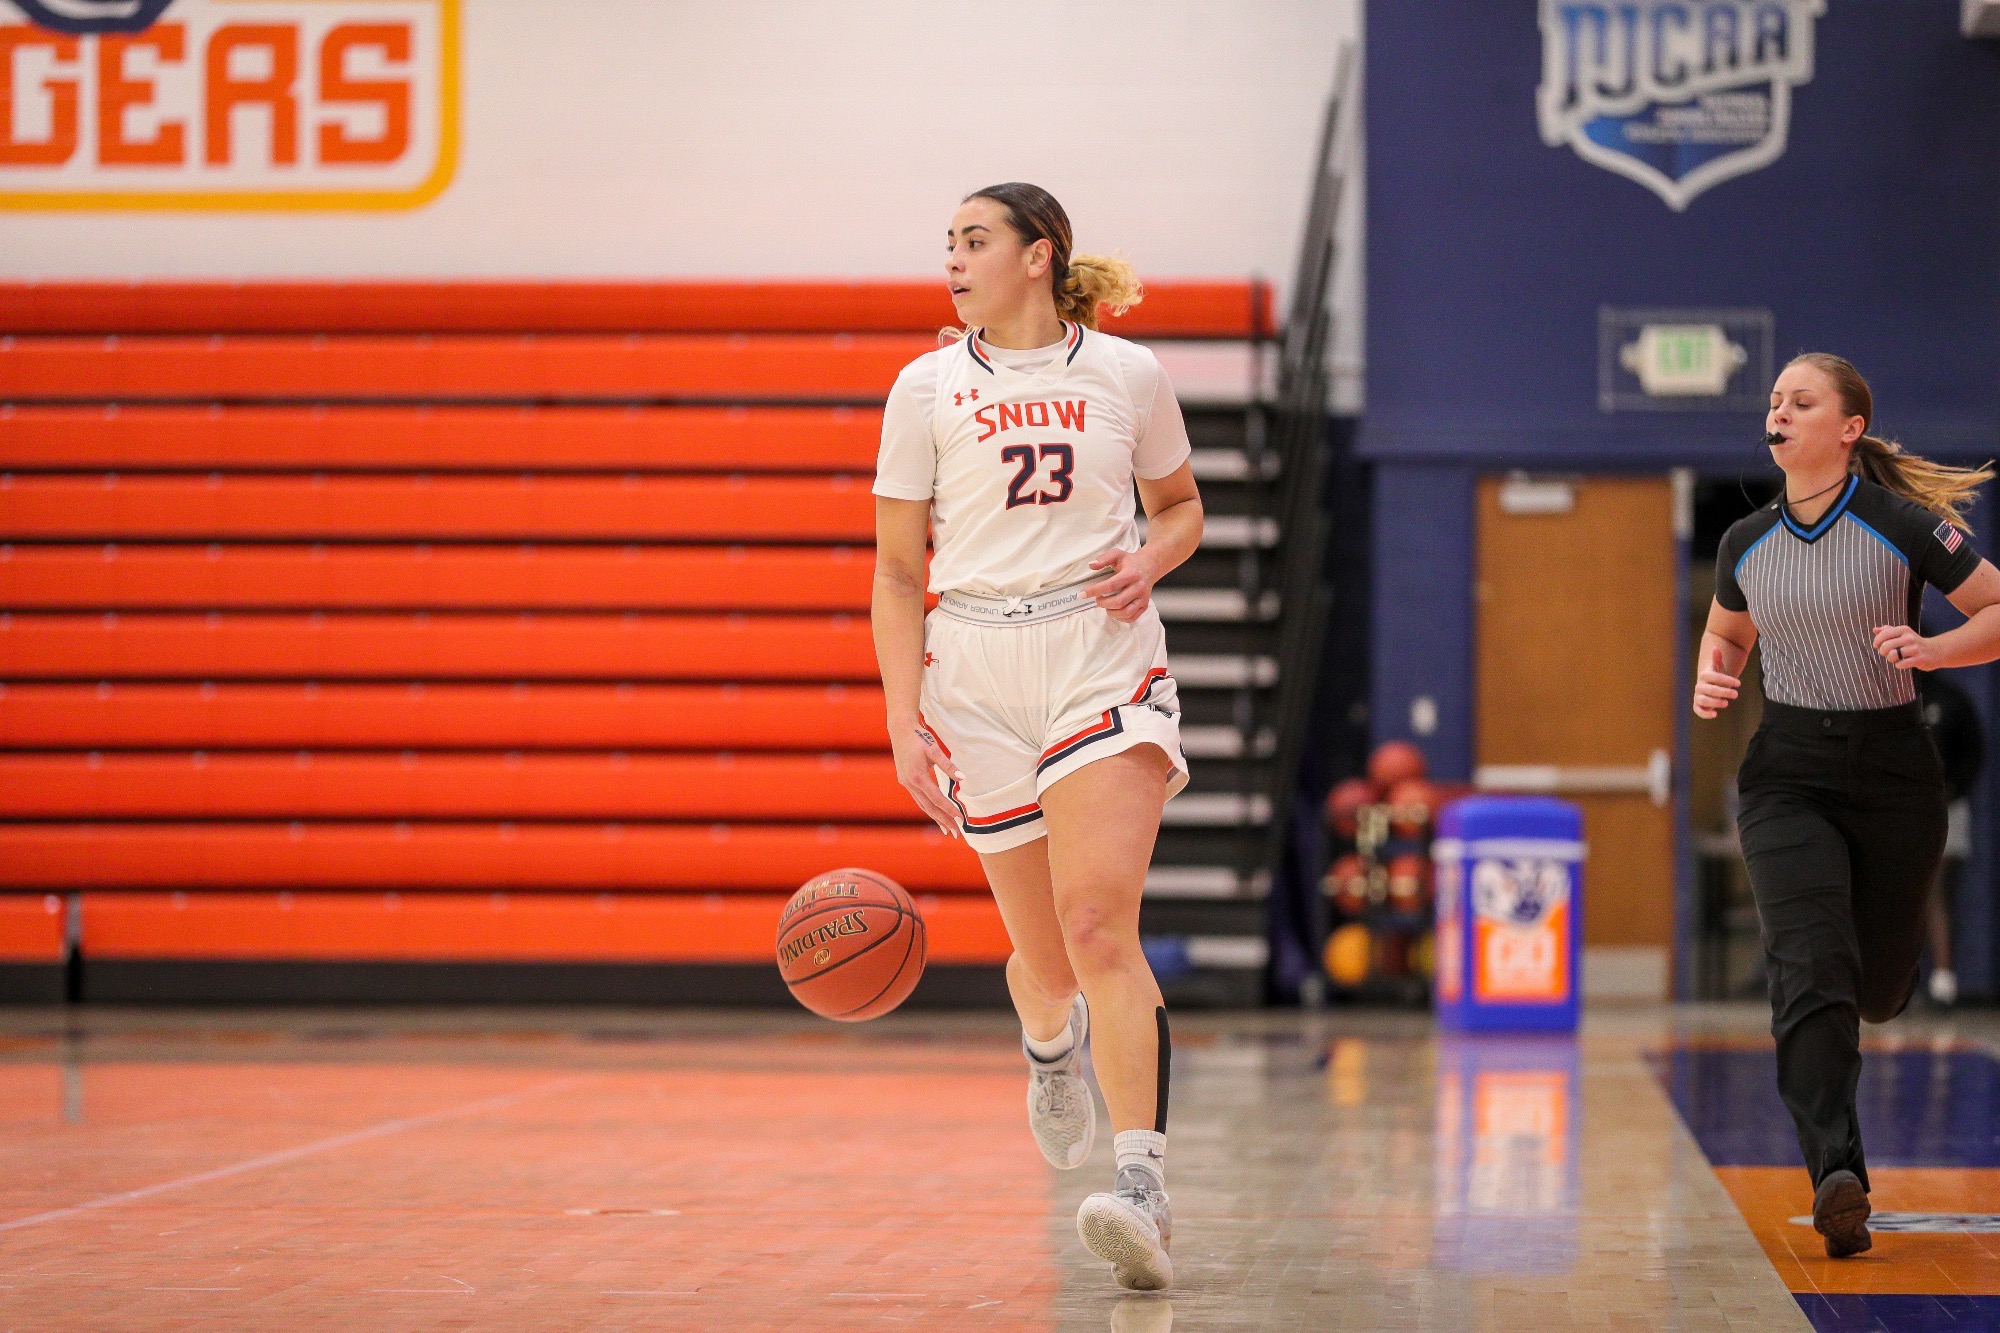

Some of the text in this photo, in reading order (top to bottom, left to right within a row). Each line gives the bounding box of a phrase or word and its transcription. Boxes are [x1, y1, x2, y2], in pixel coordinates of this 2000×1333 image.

[1557, 1, 1791, 109] NJCAA
[0, 22, 412, 166] GERS
[974, 400, 1087, 443] SNOW
[1001, 443, 1075, 511] 23
[970, 605, 999, 615] UNDER
[1037, 592, 1078, 611] ARMOUR
[779, 908, 869, 970] SPALDING
